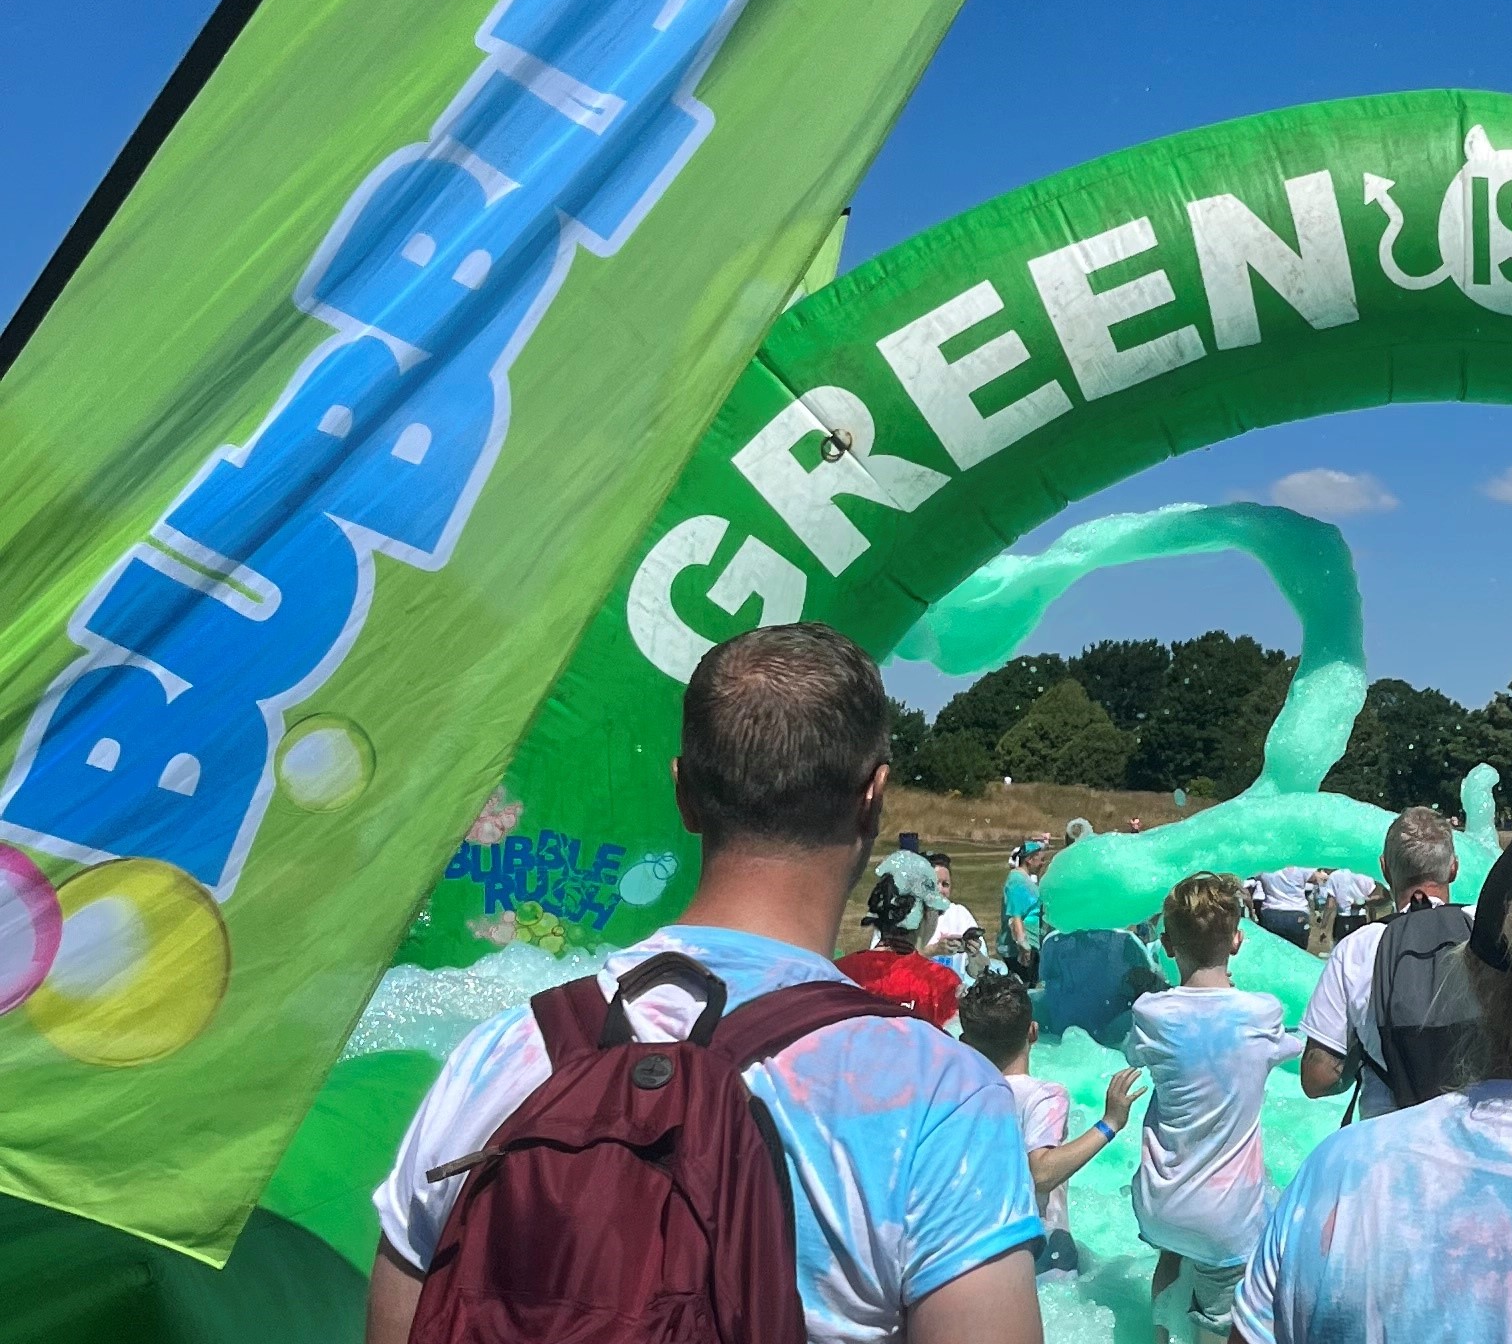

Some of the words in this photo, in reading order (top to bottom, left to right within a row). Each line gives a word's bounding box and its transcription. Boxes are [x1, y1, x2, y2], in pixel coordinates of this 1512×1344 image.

[626, 169, 1360, 685] GREEN
[444, 829, 627, 885] BUBBLE
[484, 866, 621, 930] RUSH
